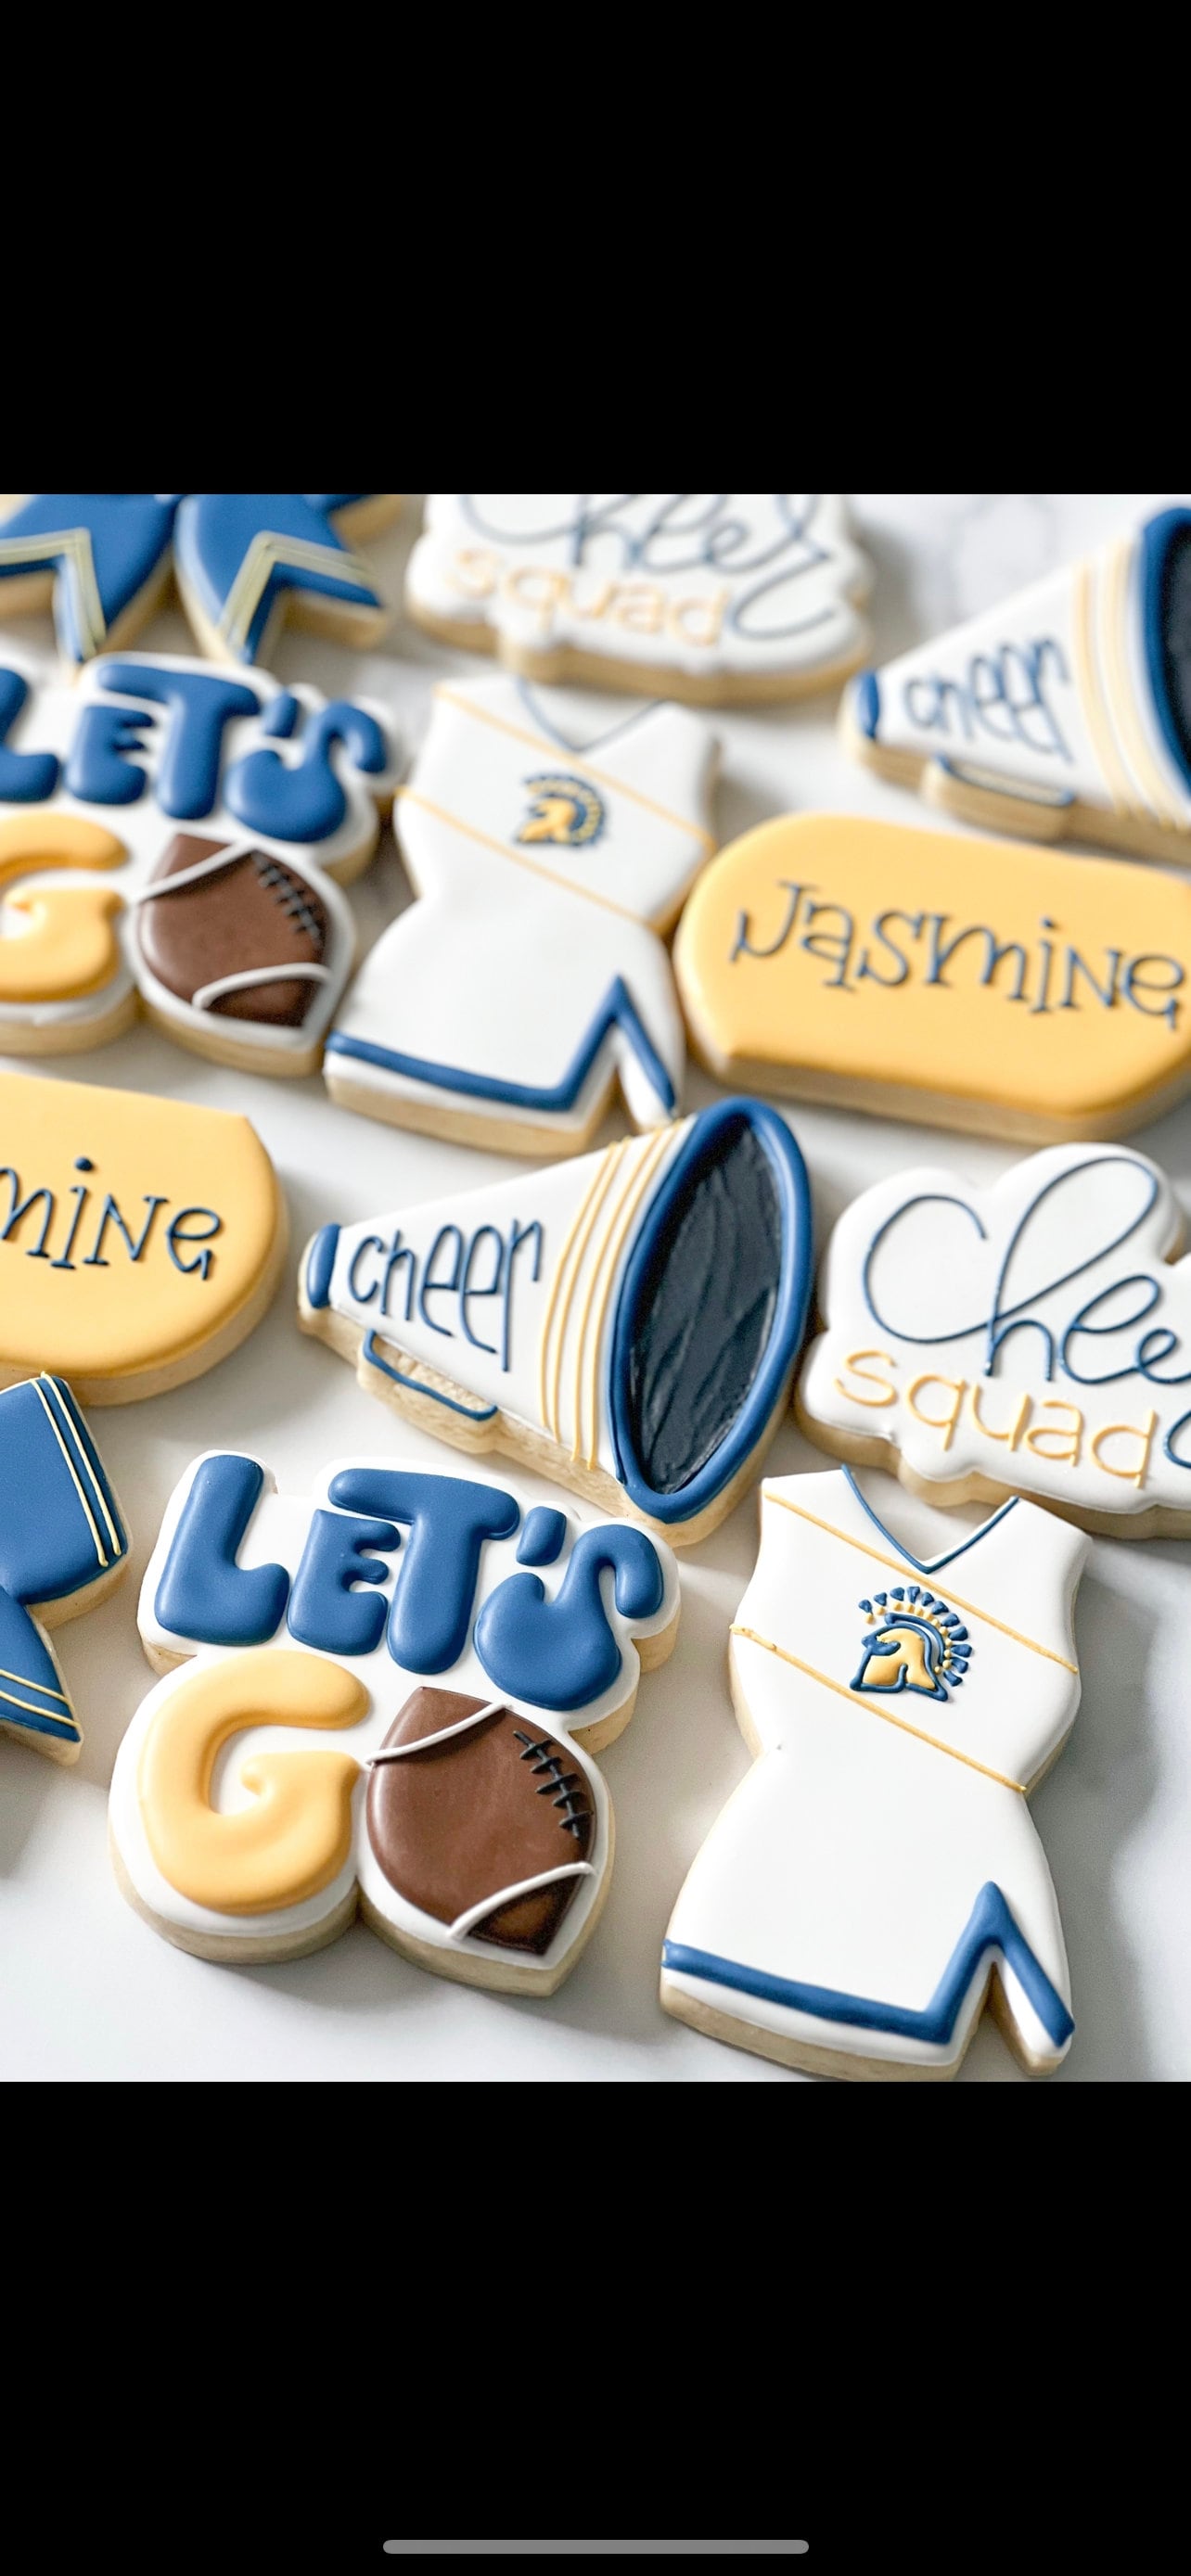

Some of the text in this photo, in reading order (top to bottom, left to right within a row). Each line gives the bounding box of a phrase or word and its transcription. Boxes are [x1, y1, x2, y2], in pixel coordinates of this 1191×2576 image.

[447, 549, 730, 646] squad
[903, 636, 1072, 763] cheer
[347, 1218, 543, 1372] cheer
[864, 1156, 1191, 1468] Chee
[837, 1349, 1158, 1489] squad
[154, 1454, 664, 1711] LET'S
